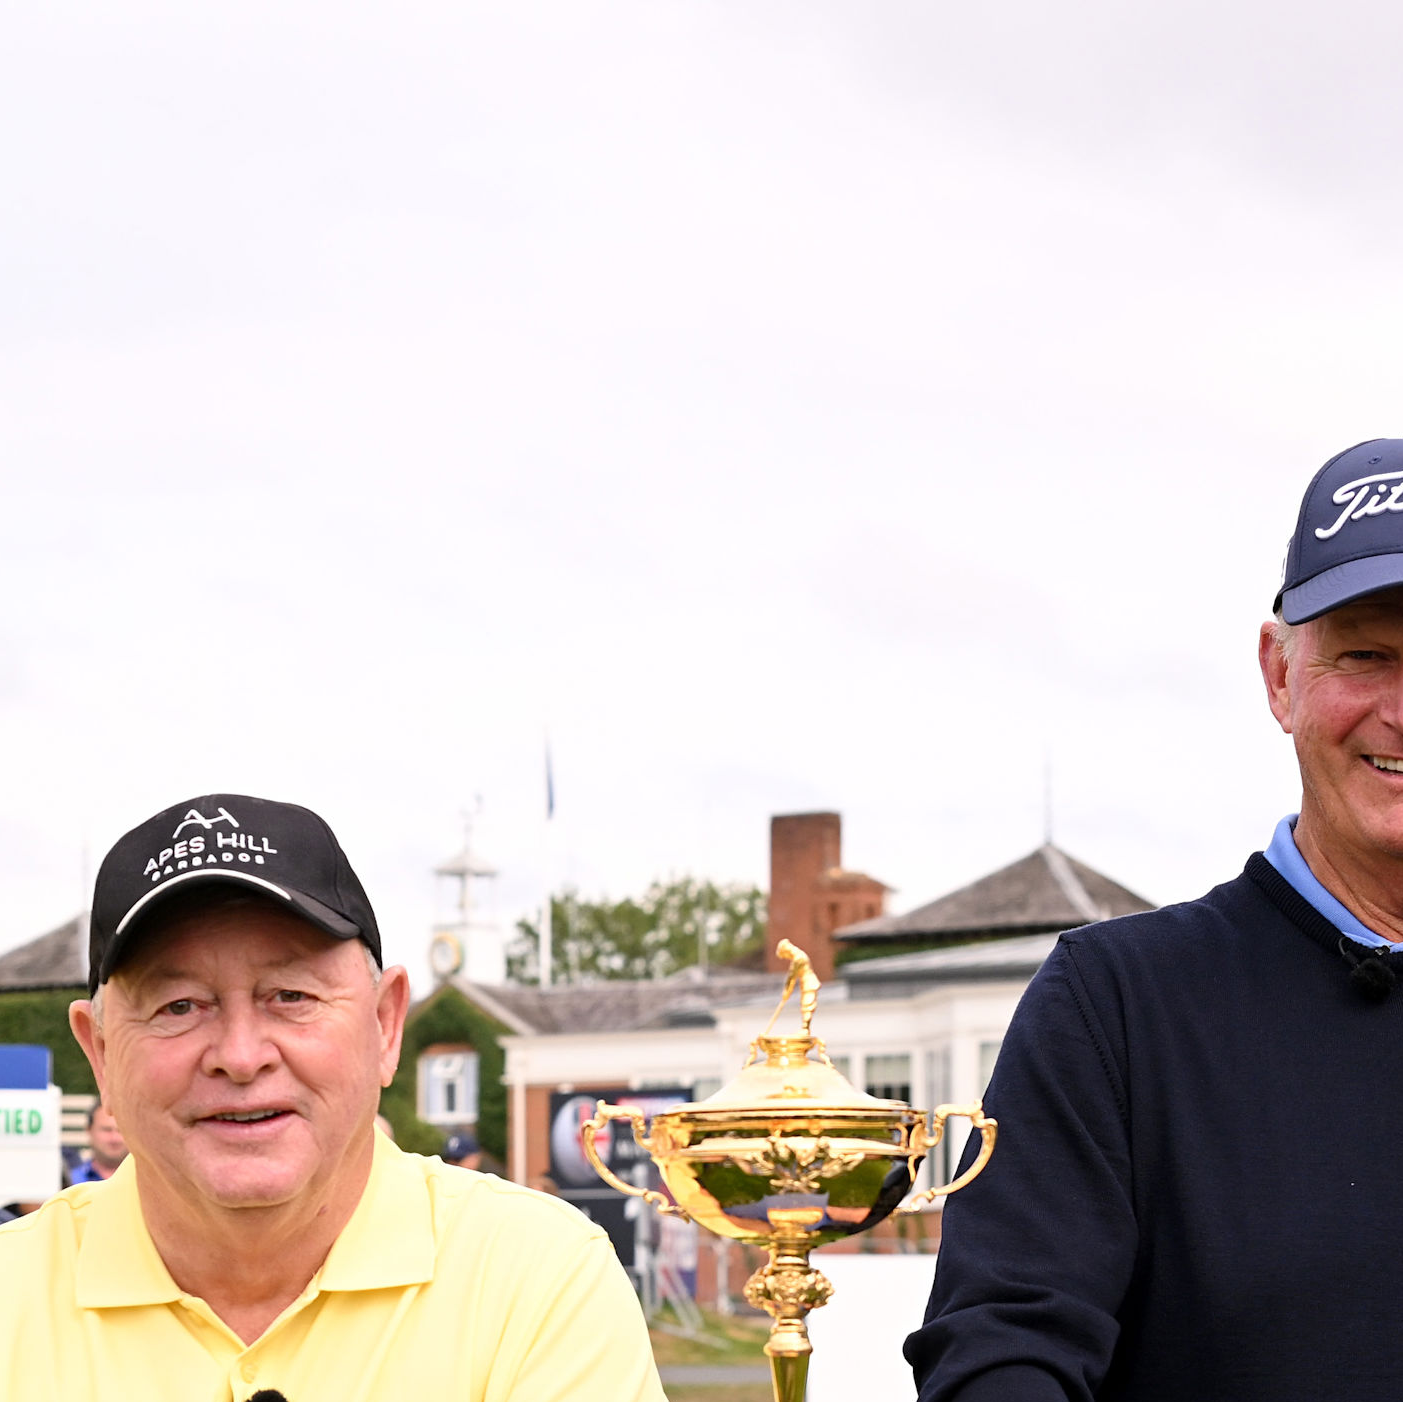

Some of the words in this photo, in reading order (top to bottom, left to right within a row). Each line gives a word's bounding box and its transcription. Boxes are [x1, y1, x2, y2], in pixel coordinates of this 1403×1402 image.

[143, 836, 205, 875] APES
[216, 832, 278, 854] HILL
[151, 852, 265, 882] BARBADOS
